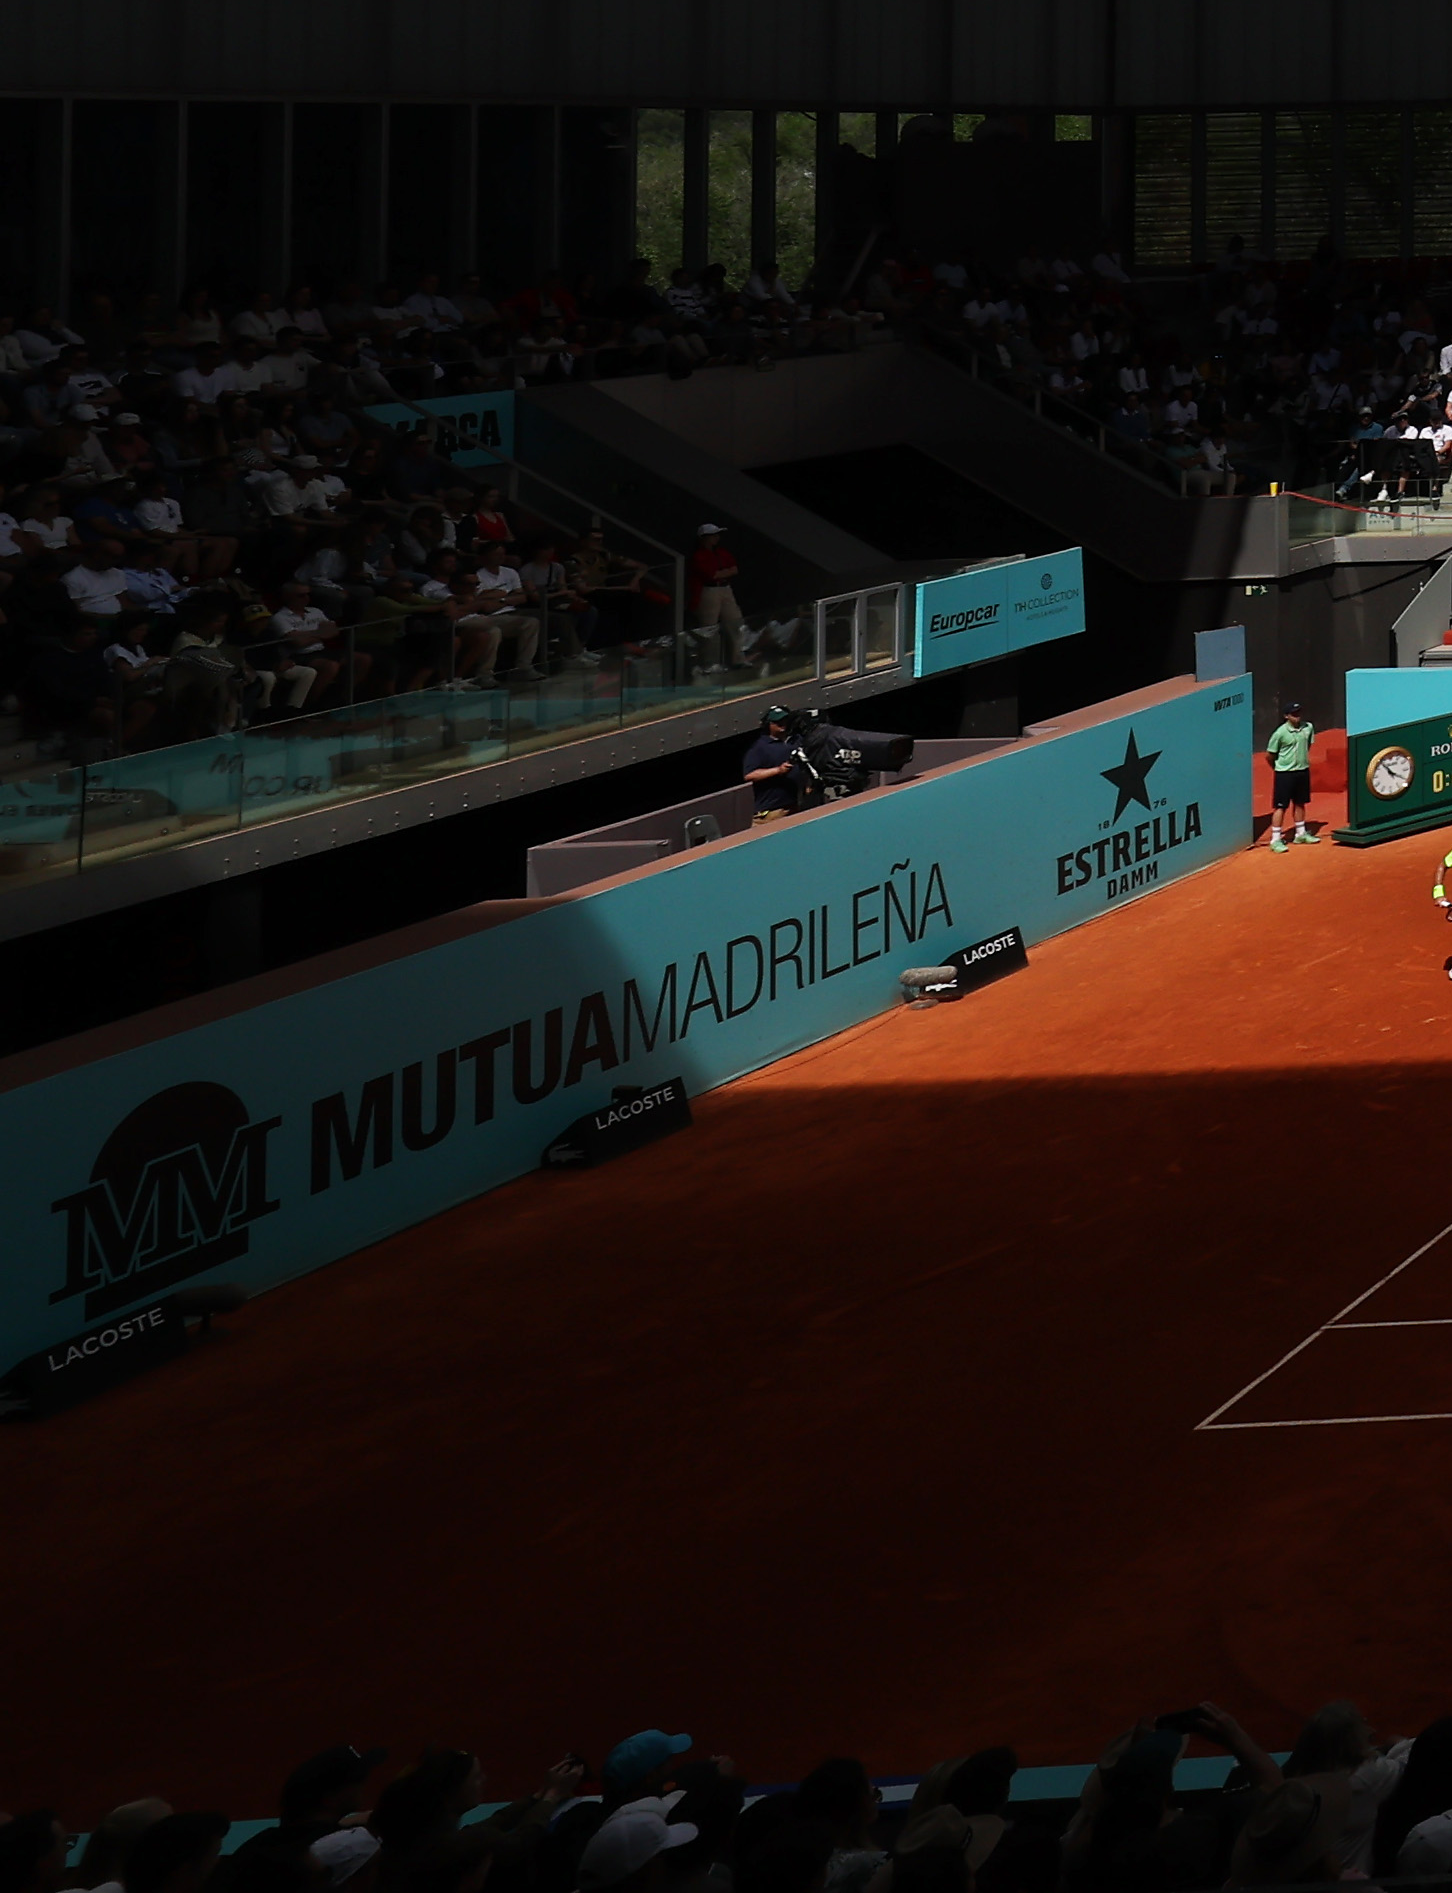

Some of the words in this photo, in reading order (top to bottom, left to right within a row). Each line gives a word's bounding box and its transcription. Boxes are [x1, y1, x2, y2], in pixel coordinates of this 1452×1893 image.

[929, 603, 1000, 633] Europcar
[1153, 797, 1167, 809] 76
[1057, 801, 1202, 896] ESTRELLA
[1106, 860, 1159, 900] DAMM
[962, 933, 1017, 966] LACOSTE
[594, 1084, 676, 1131] LACOSTE
[47, 1307, 166, 1372] LACOSTE
